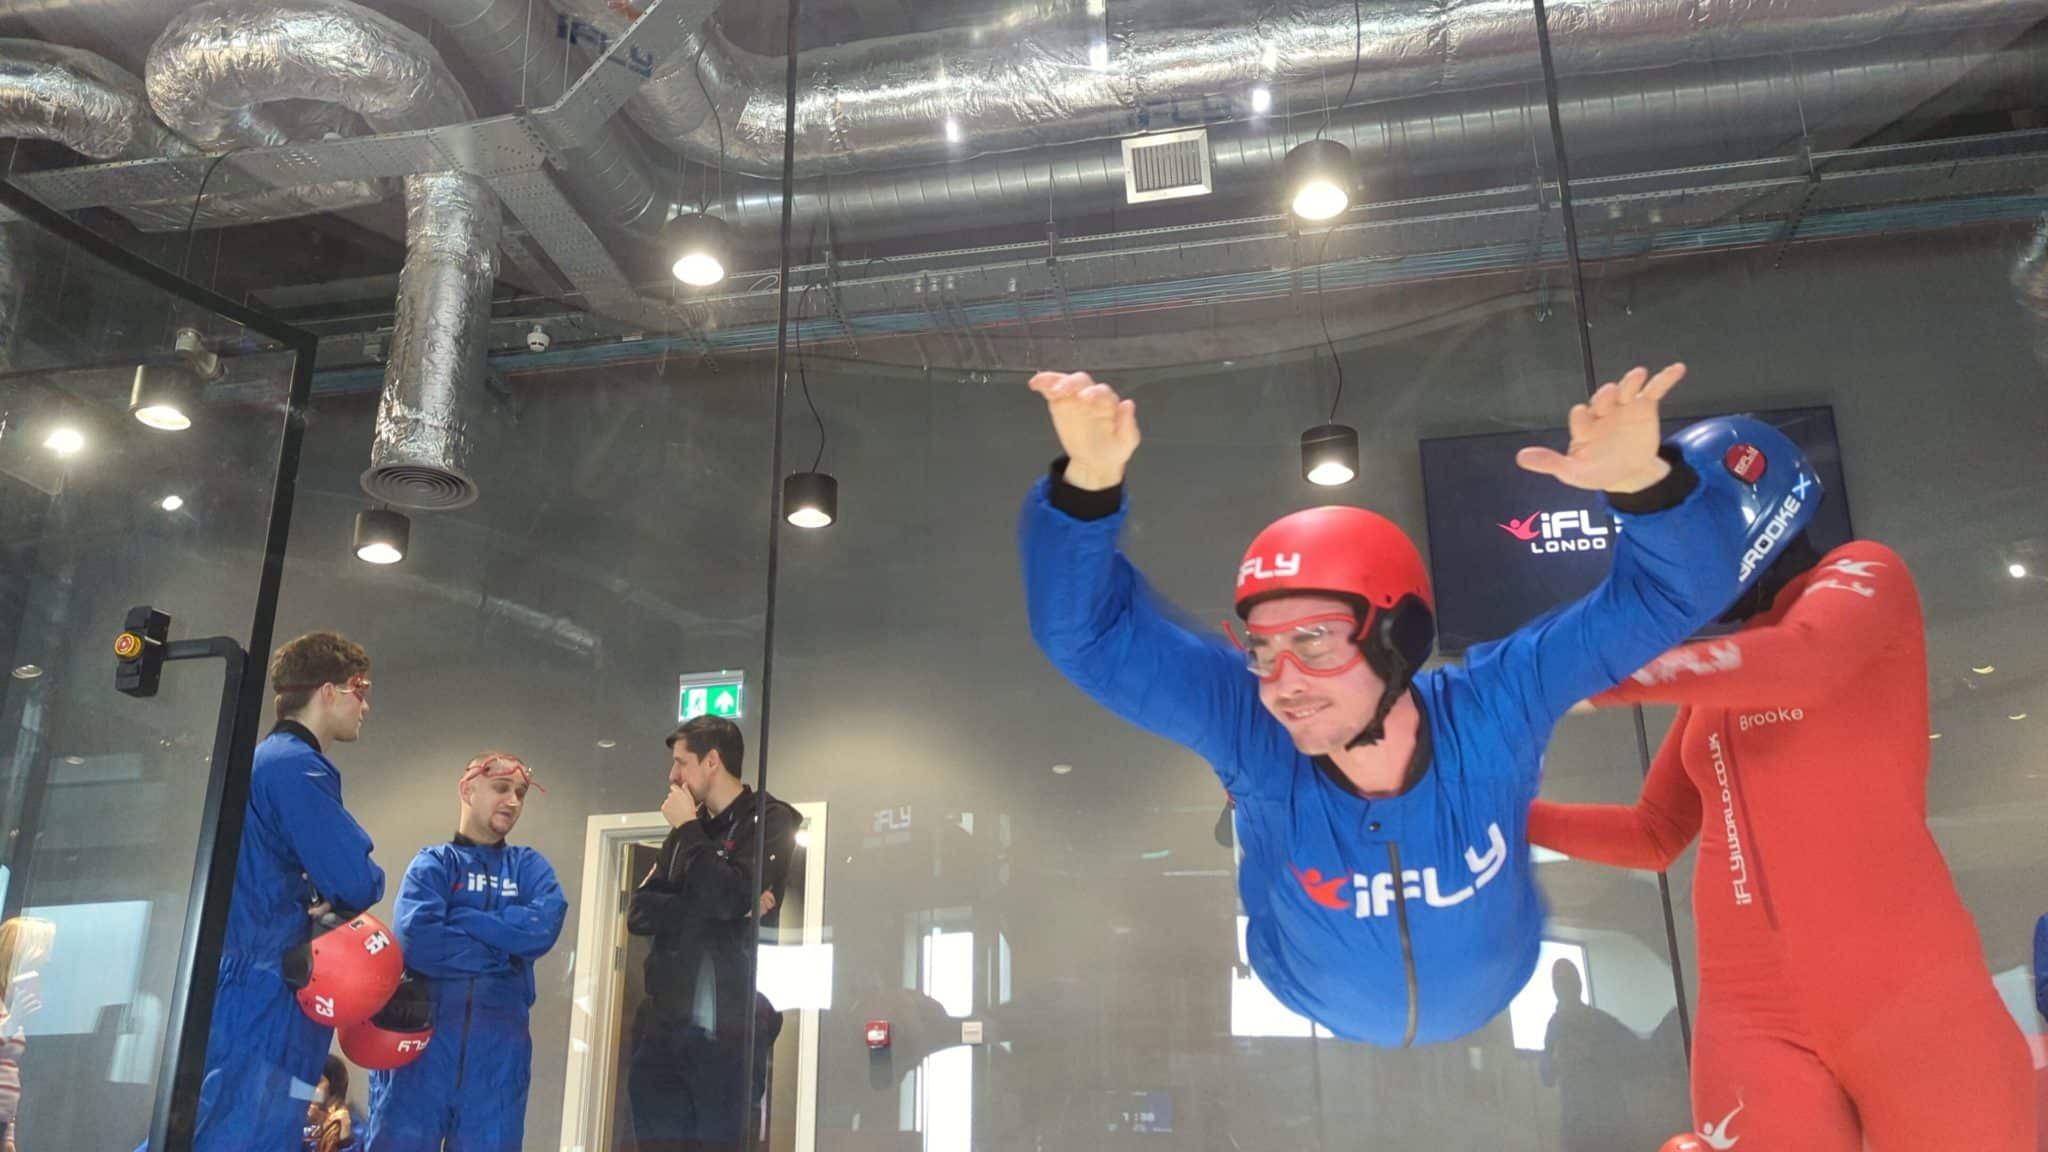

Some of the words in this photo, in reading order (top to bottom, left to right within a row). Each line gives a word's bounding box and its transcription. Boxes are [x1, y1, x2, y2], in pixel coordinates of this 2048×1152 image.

[1540, 509, 1623, 539] iFL
[1530, 537, 1607, 554] LONDO
[1739, 707, 1804, 731] Brooke
[1353, 821, 1507, 919] iFLY
[314, 995, 335, 1018] 73
